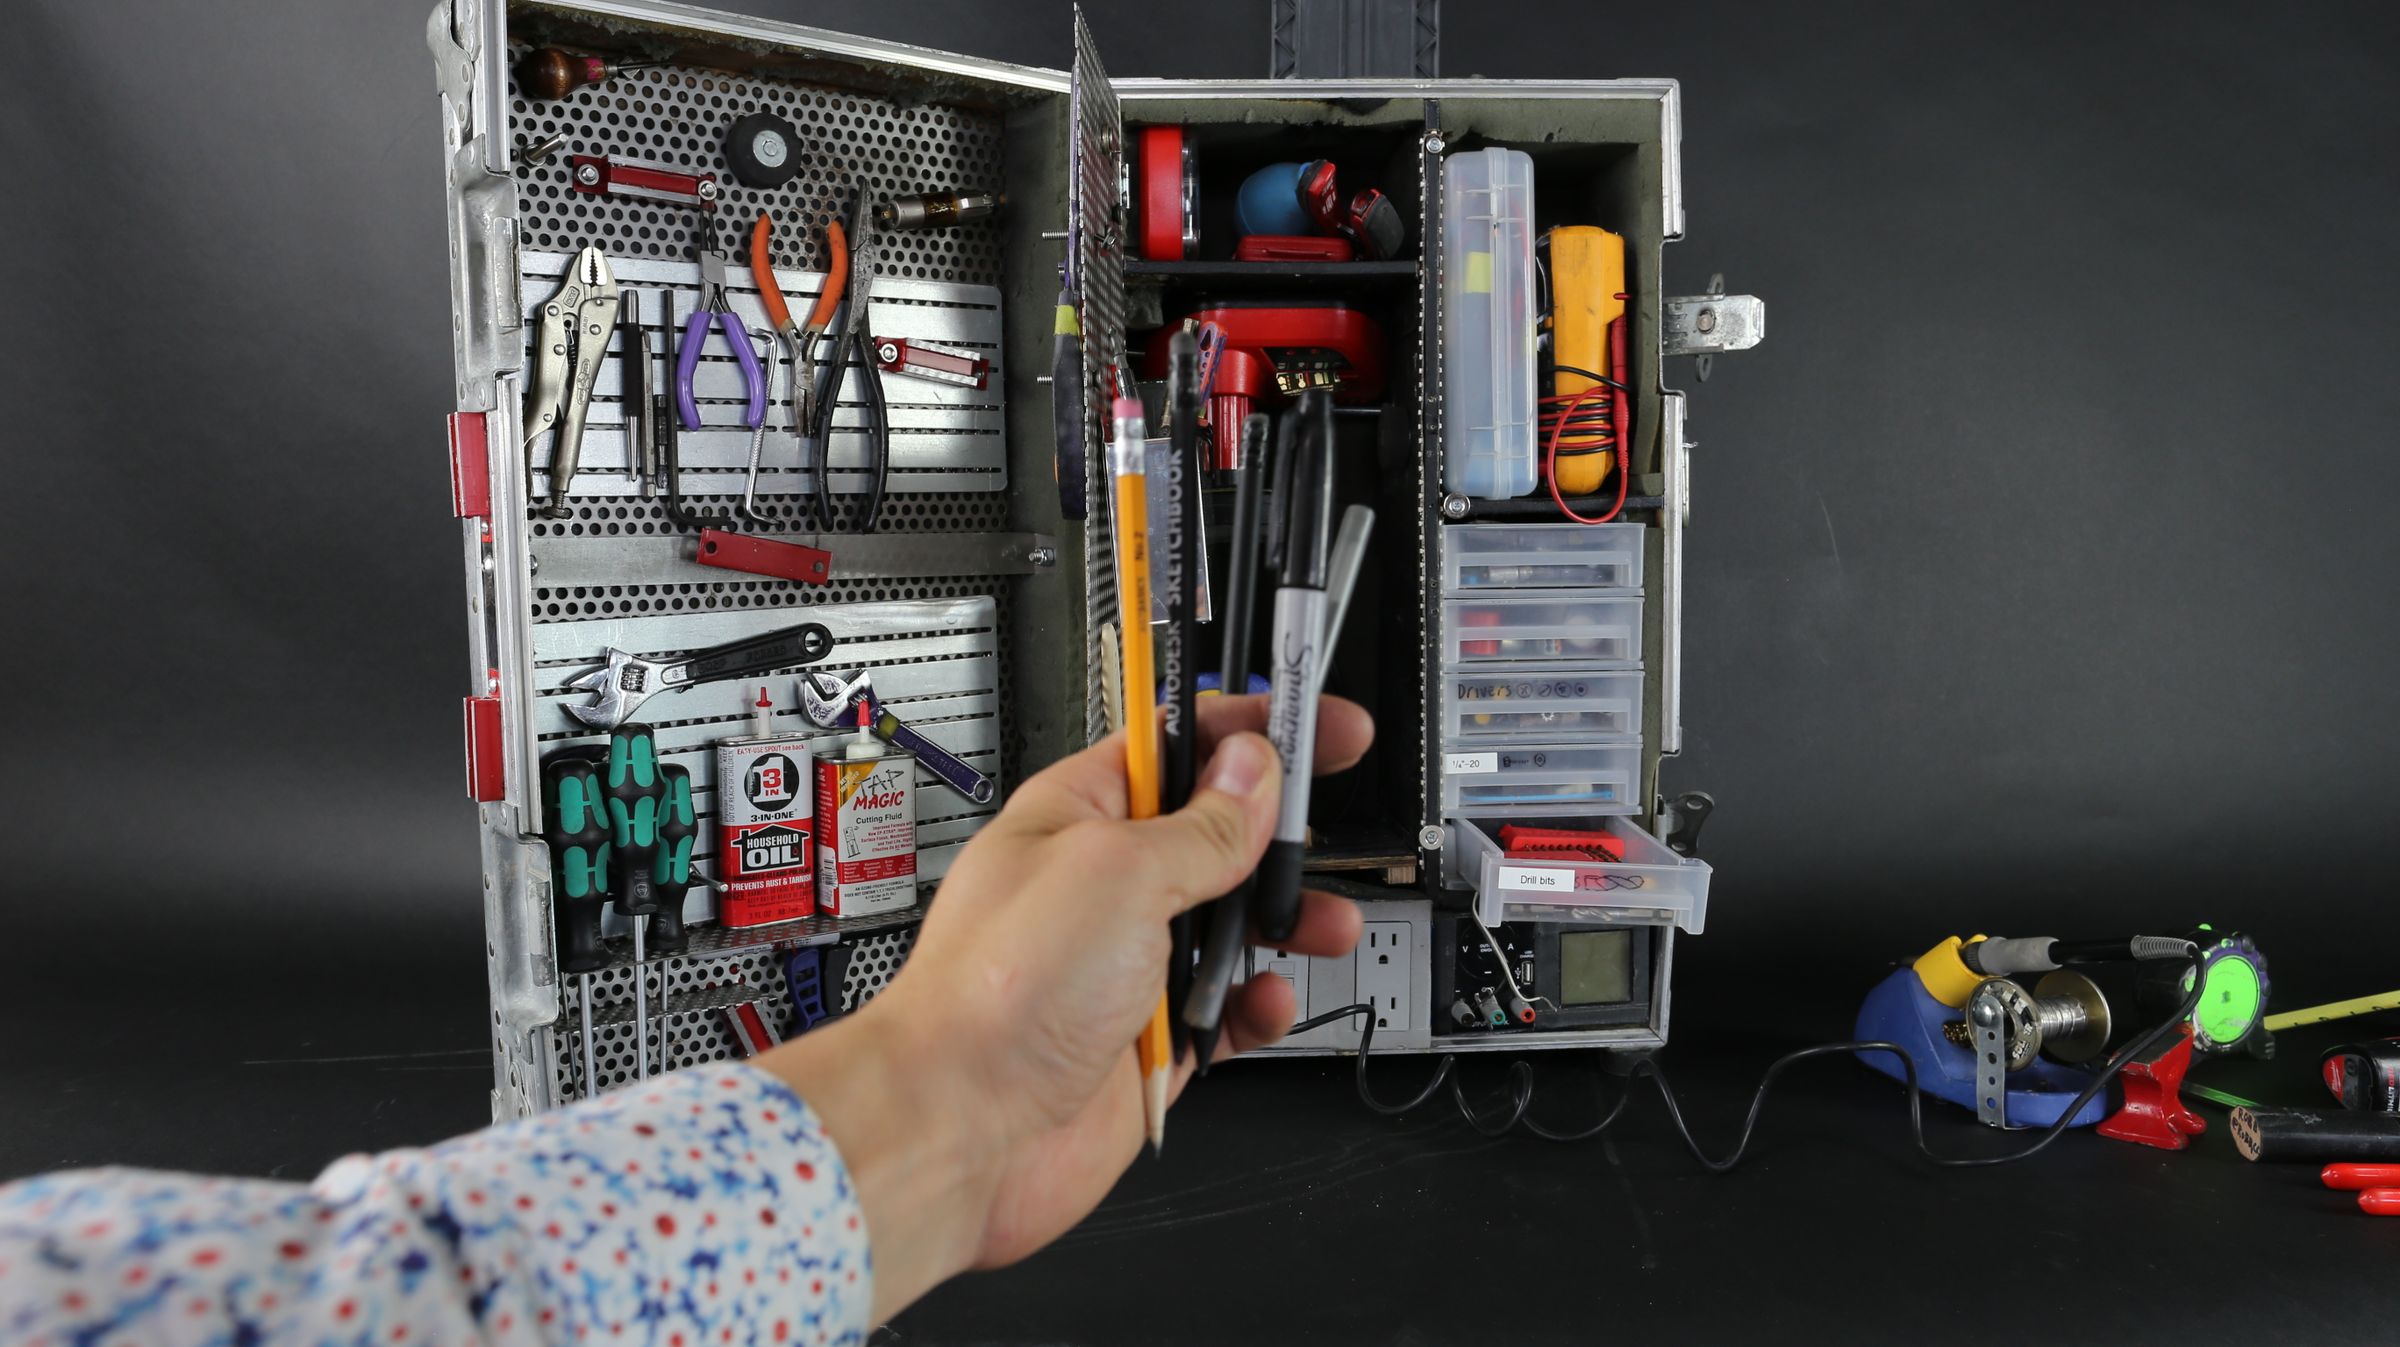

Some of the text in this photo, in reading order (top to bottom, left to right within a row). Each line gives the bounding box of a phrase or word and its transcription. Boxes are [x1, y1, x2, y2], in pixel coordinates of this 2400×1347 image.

[1165, 448, 1183, 736] AUTODESK SKETCHBOOK
[1458, 683, 1512, 699] Drivers
[762, 768, 781, 788] 3
[853, 769, 904, 797] TAP
[853, 791, 904, 811] MAGIC
[856, 813, 902, 825] Cutting Fluid
[747, 833, 799, 849] HOUSEHOLD
[746, 845, 799, 868] OIL
[731, 881, 764, 891] PREVENTS
[766, 879, 781, 888] RUST
[783, 877, 788, 885] &
[1520, 875, 1555, 886] Drill bits
[1462, 945, 1468, 953] V
[1507, 943, 1514, 951] A
